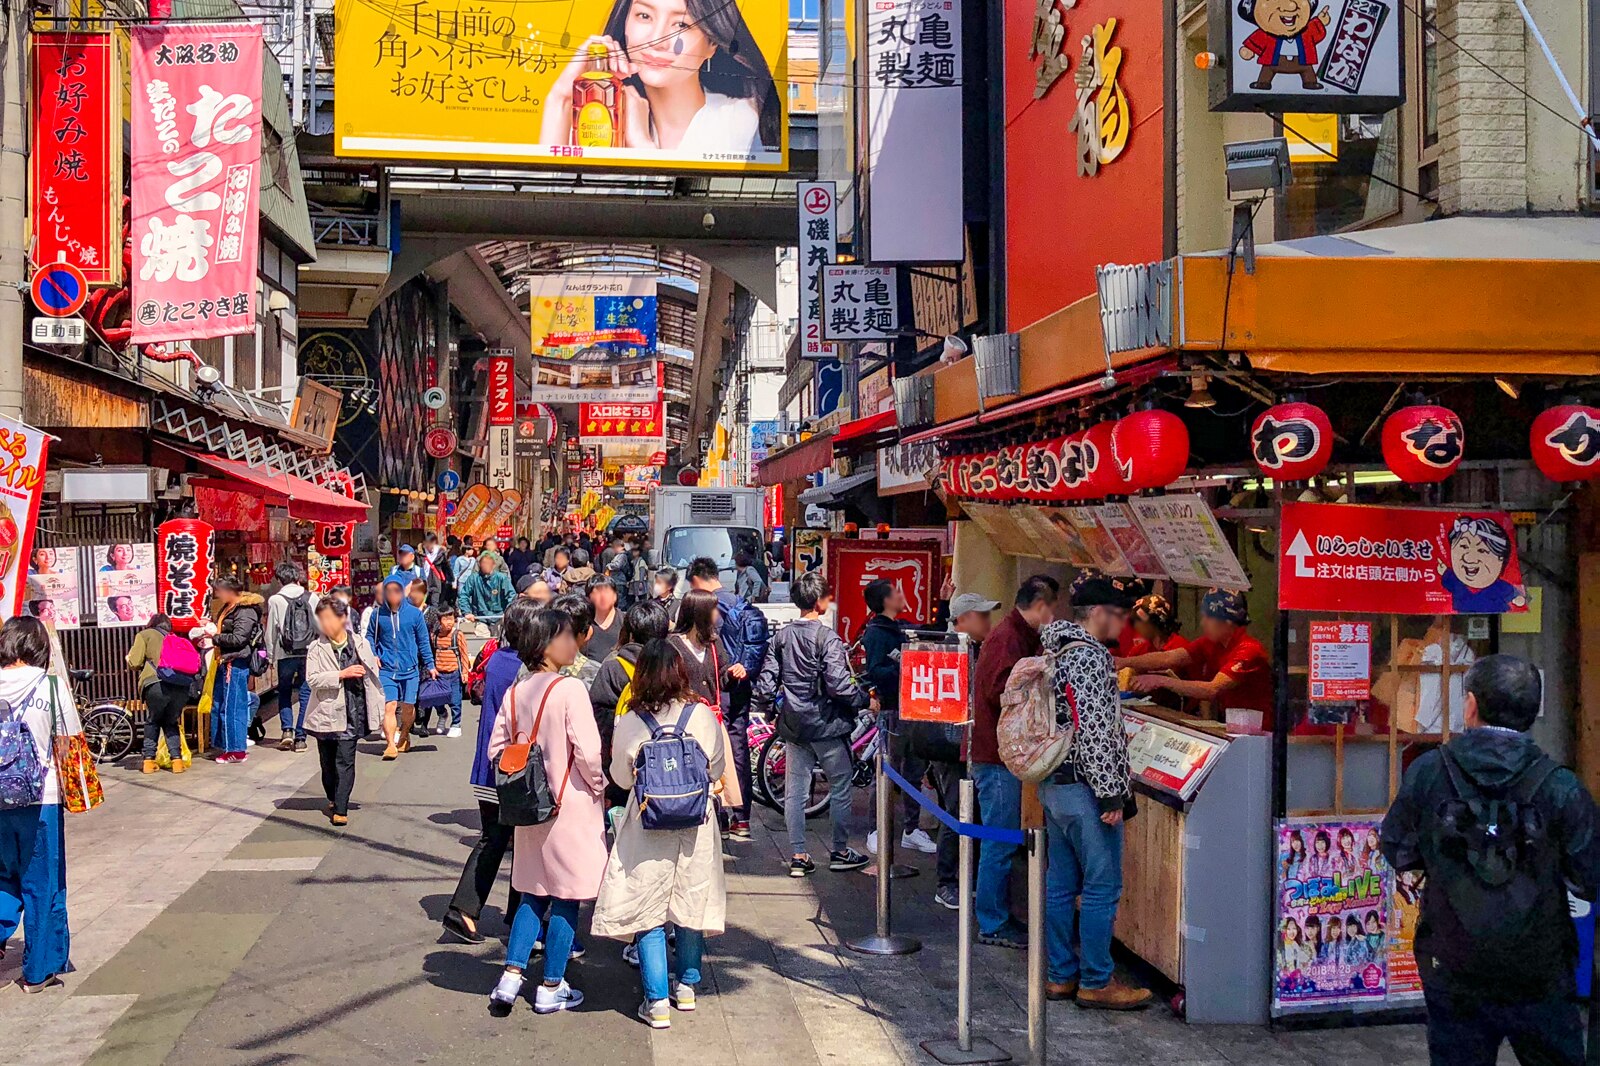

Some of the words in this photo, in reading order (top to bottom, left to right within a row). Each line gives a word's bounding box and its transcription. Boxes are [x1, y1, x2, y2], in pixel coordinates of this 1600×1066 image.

[400, 1, 516, 39] 千日前の
[876, 13, 953, 49] 丸亀
[154, 42, 239, 66] 大阪名物
[374, 31, 557, 75] 角ハイボールが
[1328, 11, 1373, 82] わなか
[875, 52, 955, 87] 製麺
[391, 71, 540, 106] お好きでしょ。
[54, 52, 89, 182] お好み焼
[550, 146, 583, 158] 千日前
[139, 84, 254, 283] たこ焼
[43, 186, 99, 266] もんじゃ焼
[219, 167, 249, 259] お好み焼
[162, 293, 249, 323] たこやき座
[831, 277, 891, 306] 丸亀
[34, 323, 82, 339] 自動車
[829, 307, 893, 334] 製麺
[495, 360, 509, 413] カラオケ
[592, 406, 651, 417] 入口はこちら
[1254, 417, 1321, 467] わ
[1402, 417, 1464, 466] な
[1316, 535, 1433, 560] いらっしゃいませ
[165, 534, 198, 618] 焼そば
[1316, 562, 1436, 583] 注文は店頭左側から
[911, 665, 960, 701] 出口
